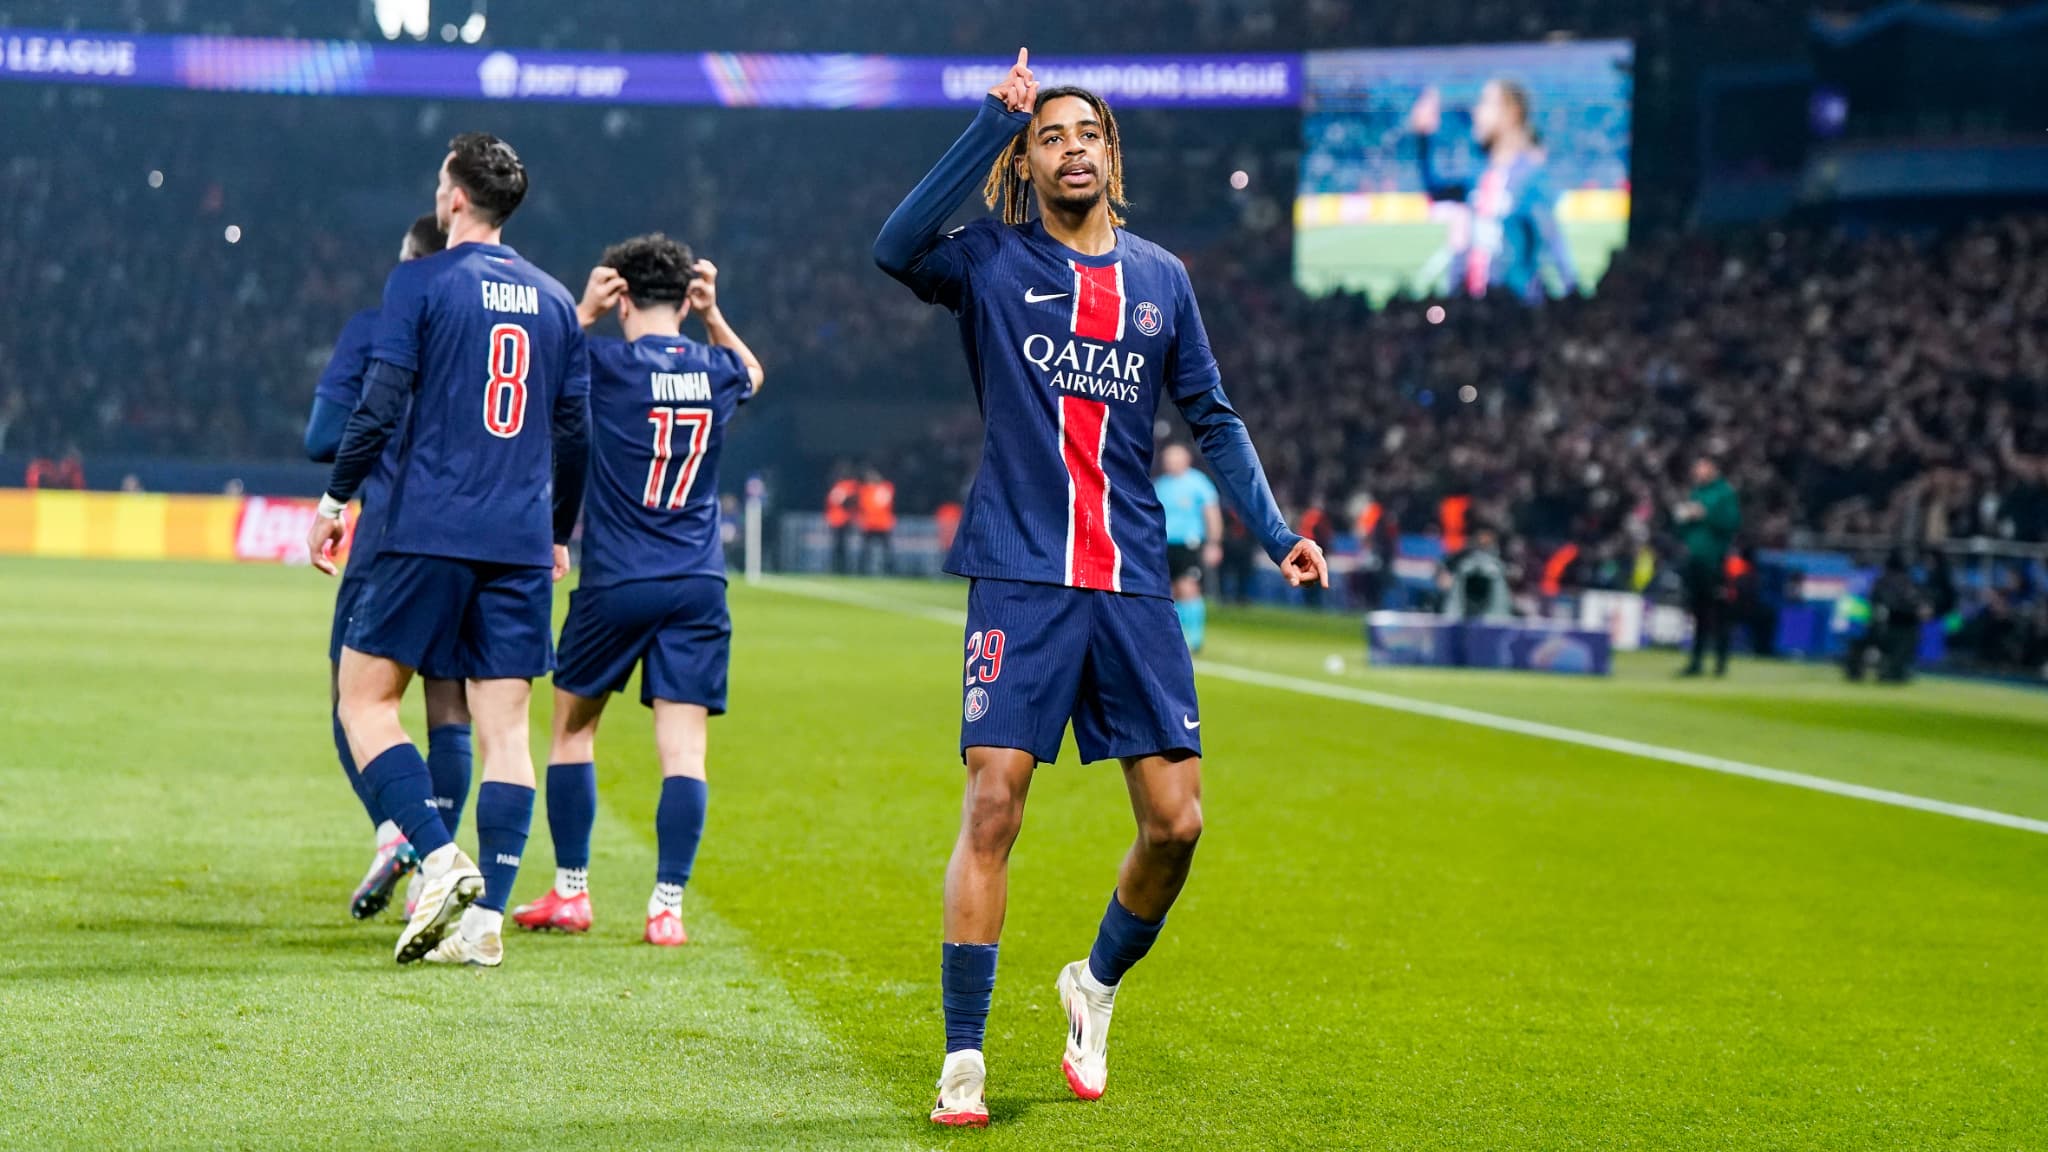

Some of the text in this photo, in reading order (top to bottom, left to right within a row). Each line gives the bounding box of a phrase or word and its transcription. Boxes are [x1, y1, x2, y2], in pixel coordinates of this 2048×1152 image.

[7, 36, 137, 76] LEAGUE
[481, 280, 539, 315] FABIAN
[483, 323, 530, 438] 8
[1023, 334, 1145, 383] QATAR
[651, 371, 712, 401] VITINHA
[1050, 370, 1139, 403] AIRWAYS
[643, 407, 712, 510] 17
[966, 629, 1005, 686] 29
